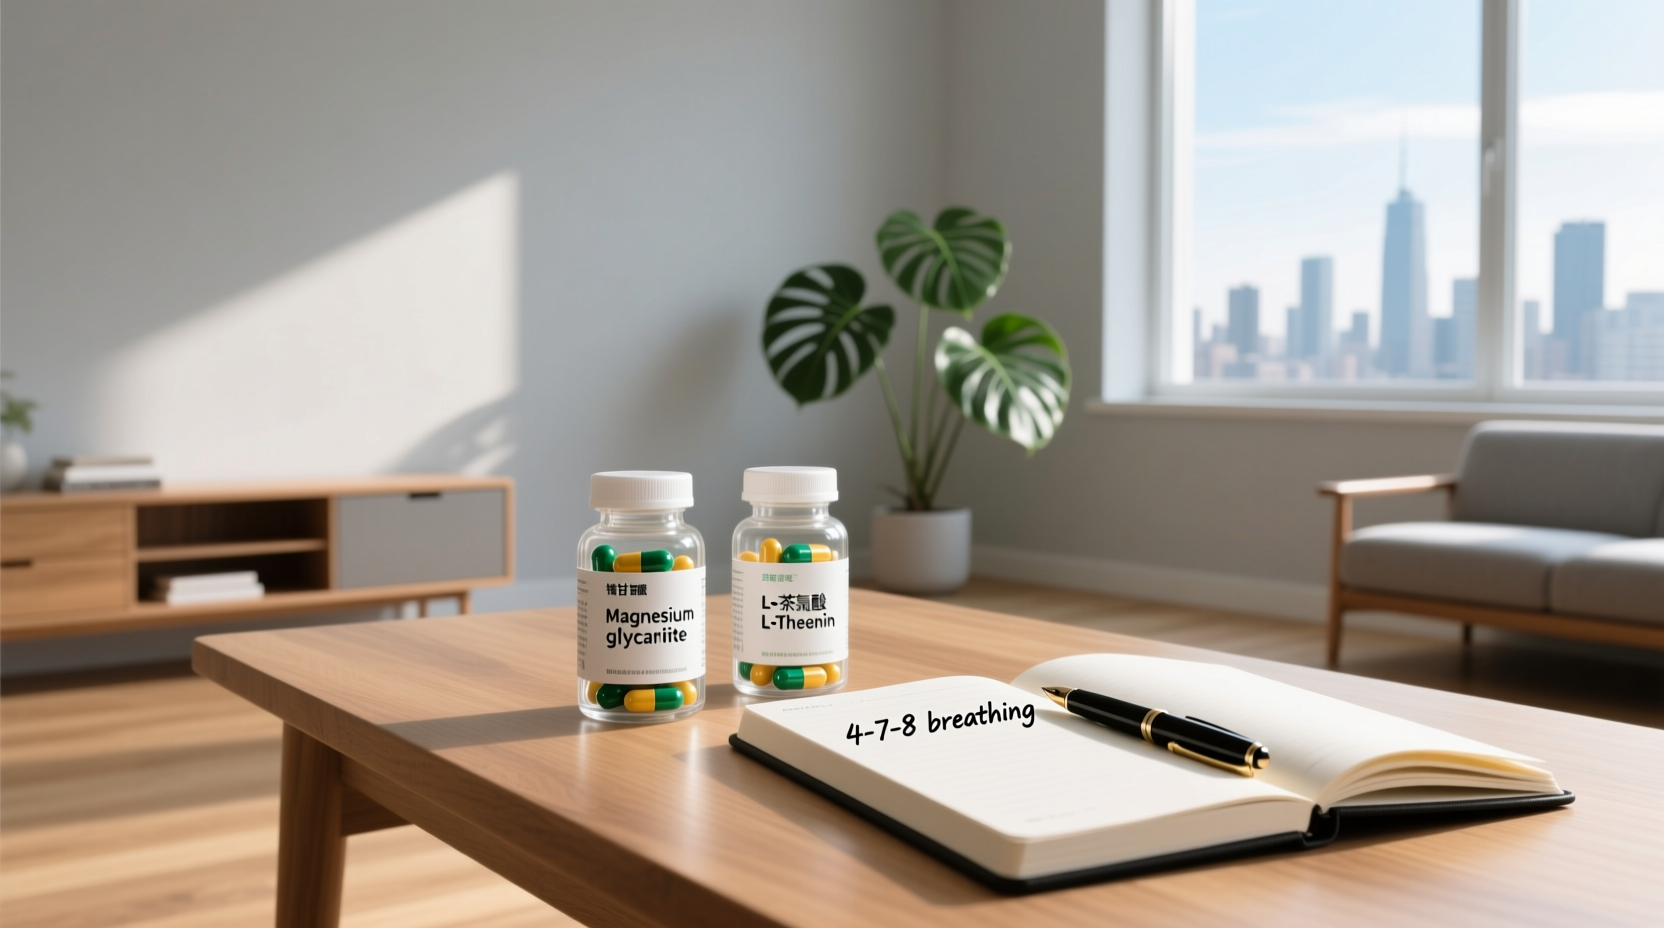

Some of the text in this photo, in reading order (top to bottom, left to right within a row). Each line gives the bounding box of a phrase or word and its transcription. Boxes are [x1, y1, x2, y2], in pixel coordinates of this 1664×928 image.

[606, 607, 694, 628] Magnesium
[761, 612, 835, 630] L-Theenin
[846, 701, 1035, 746] 4-7-8 breathing
